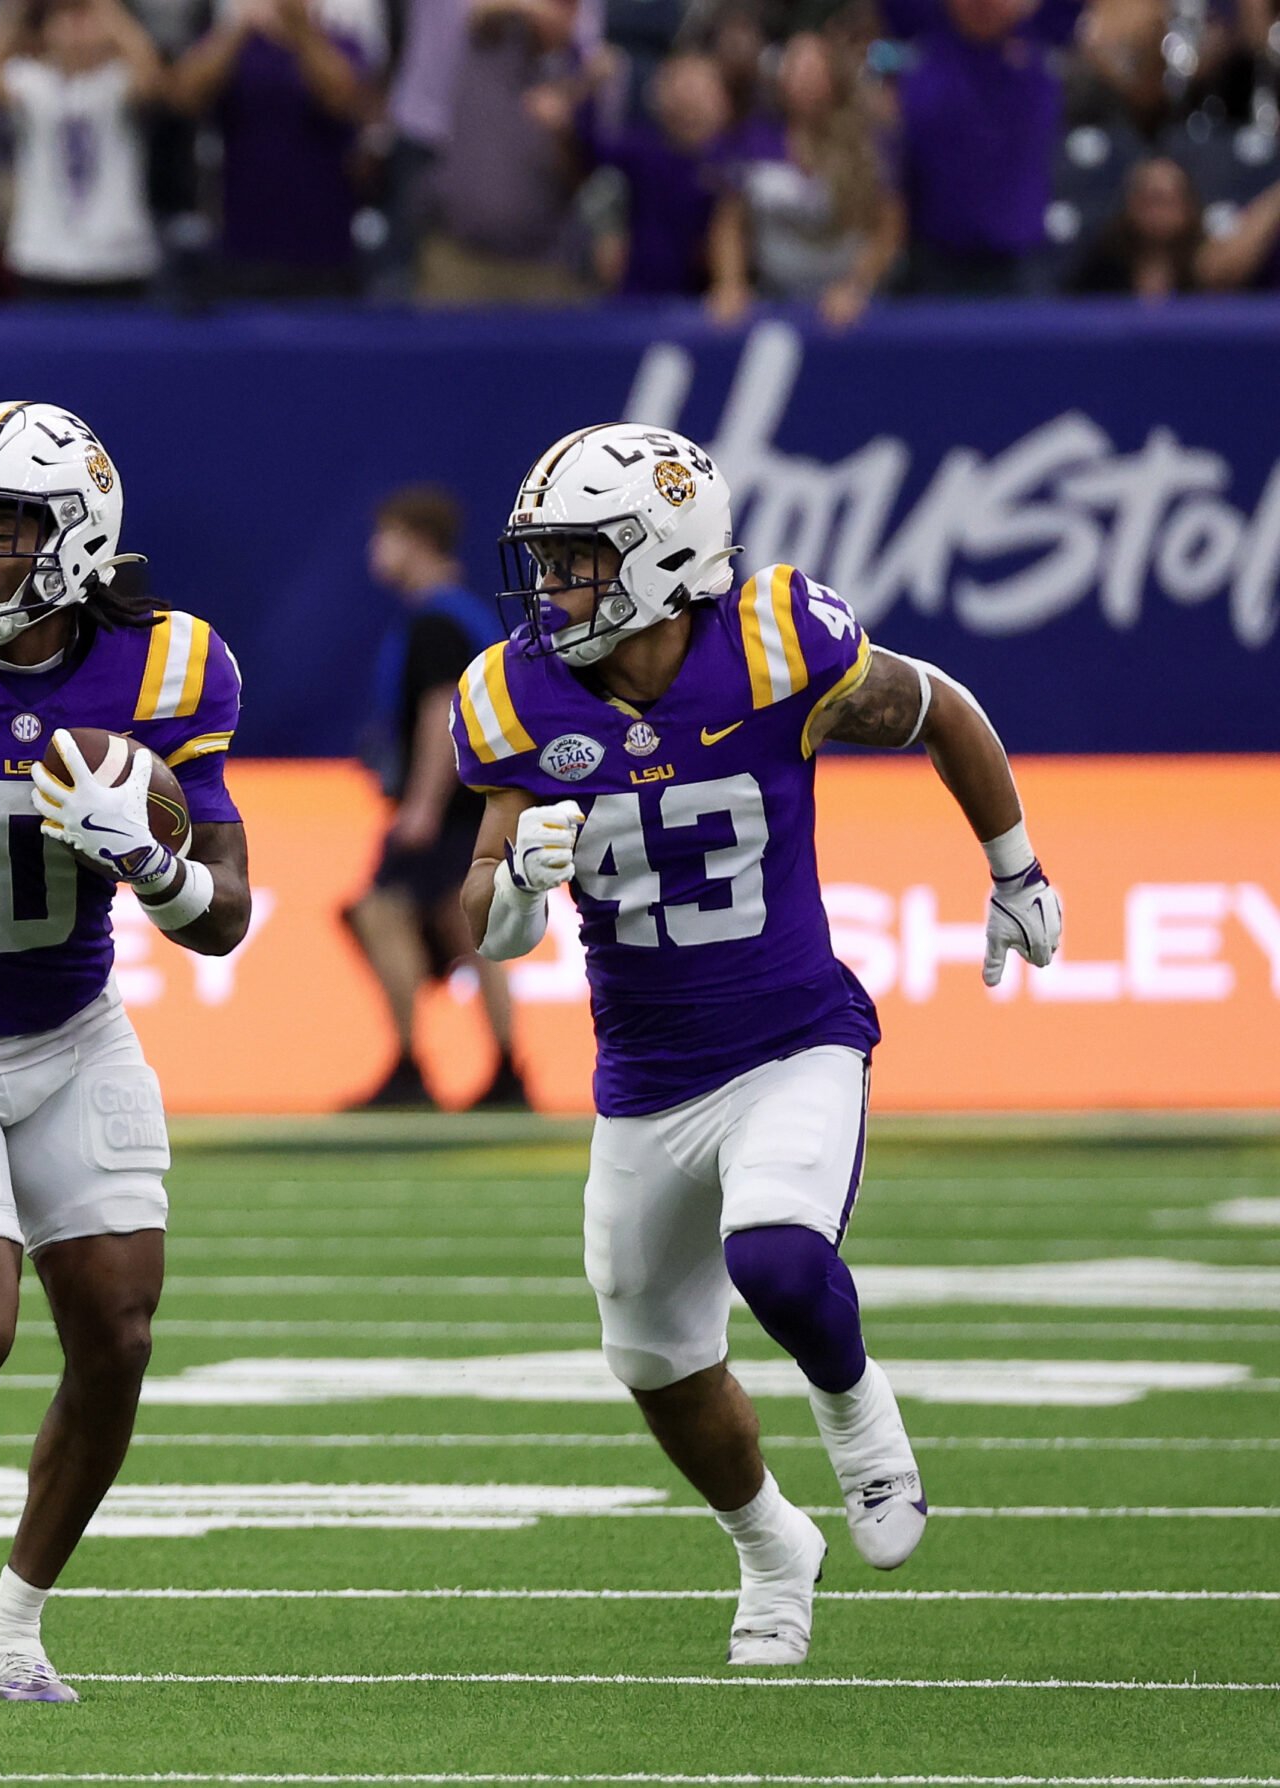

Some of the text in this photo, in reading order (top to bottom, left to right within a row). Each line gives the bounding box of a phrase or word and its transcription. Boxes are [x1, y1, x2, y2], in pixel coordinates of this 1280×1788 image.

[35, 416, 98, 449] LS
[14, 715, 39, 740] SEC
[629, 724, 652, 748] SEC
[4, 759, 34, 775] LS
[547, 746, 596, 771] TEXAS
[630, 763, 675, 785] LSU
[570, 771, 769, 948] 43
